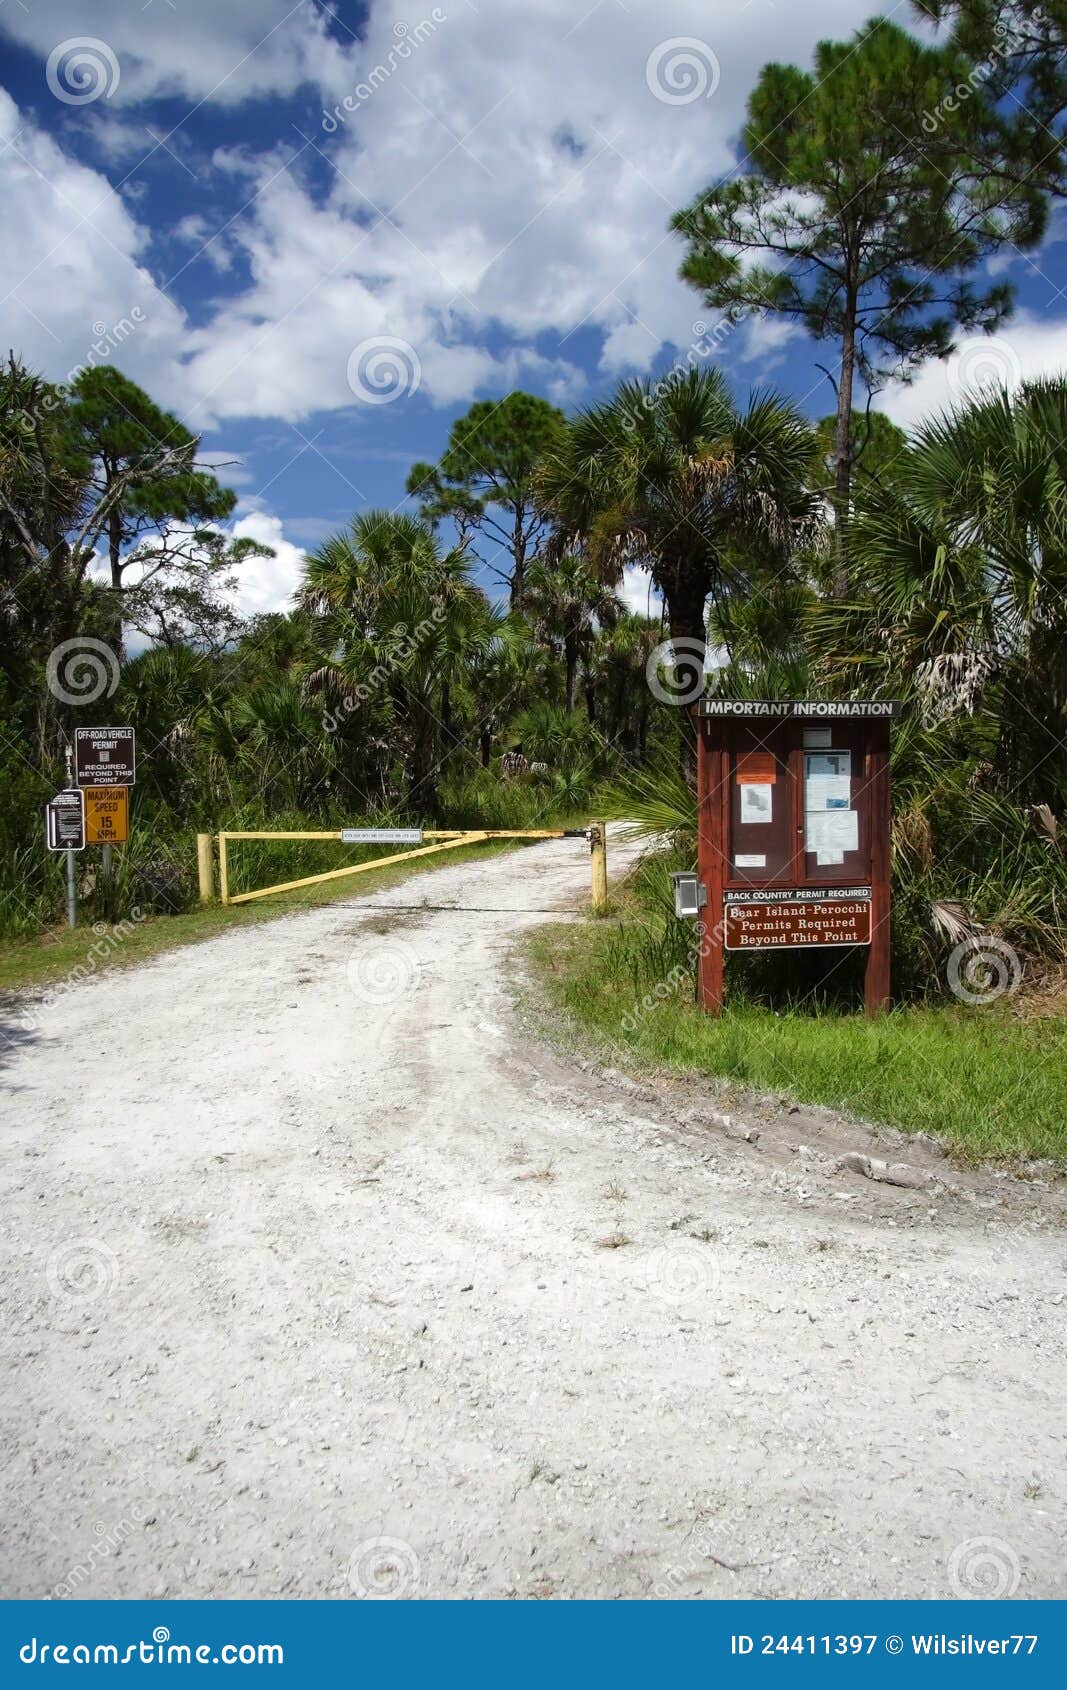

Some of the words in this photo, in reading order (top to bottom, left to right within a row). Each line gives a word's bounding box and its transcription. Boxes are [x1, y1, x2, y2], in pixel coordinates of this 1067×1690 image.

[705, 702, 789, 715] IMPORTANT
[793, 702, 893, 715] INFORMATION
[78, 730, 107, 739] OFF-ROAD
[107, 730, 132, 739] VEHICLE
[92, 741, 118, 749] PERMIT
[88, 791, 124, 800] MAXIMUM
[94, 803, 118, 812] SPEED
[100, 816, 113, 828] 15
[97, 830, 117, 839] MPH
[727, 892, 751, 900] BACK
[752, 891, 793, 900] COUNTRY
[796, 890, 826, 898] PERMIT
[828, 889, 869, 897] REQUIRED
[730, 908, 760, 918] Bear
[766, 903, 868, 917] Island-Perocchi
[741, 920, 792, 931] Permits
[798, 917, 856, 930] Required
[740, 934, 787, 946] Beyond
[791, 932, 818, 942] This
[824, 931, 858, 941] Point
